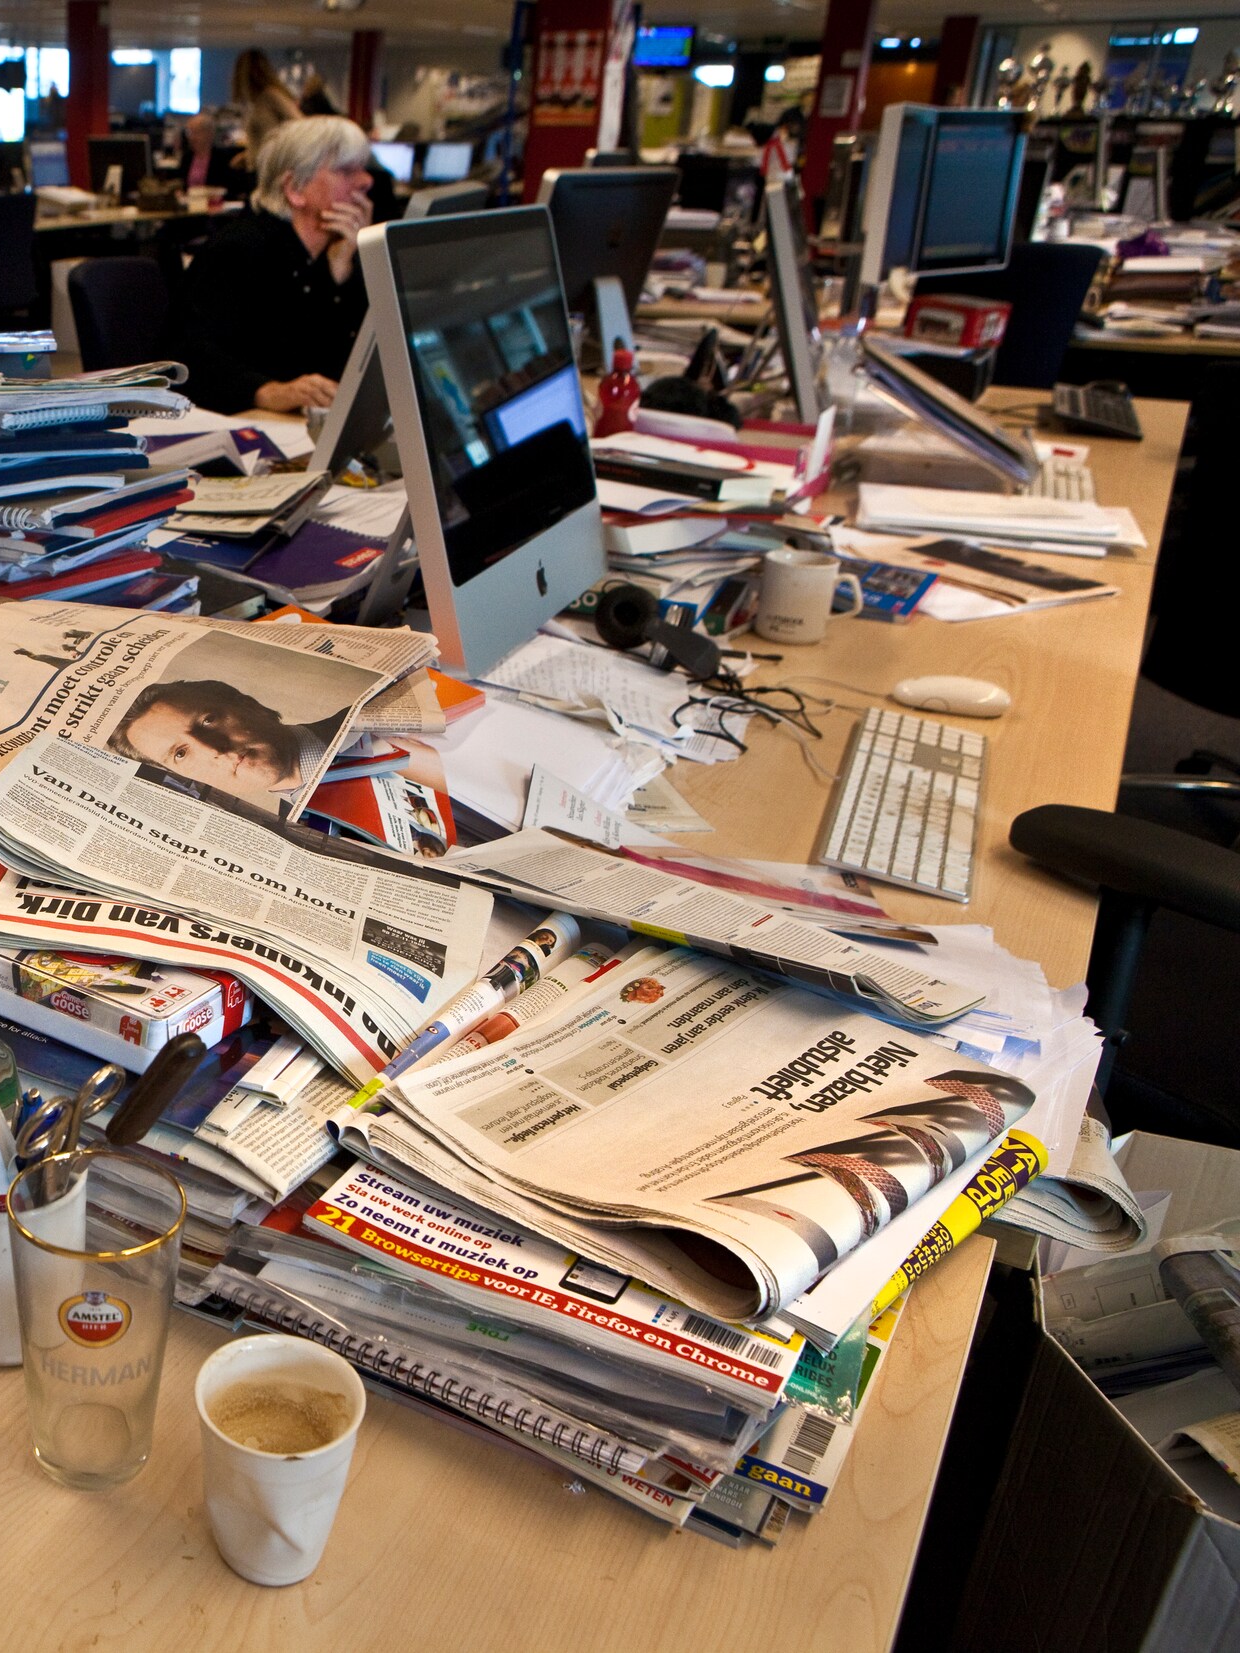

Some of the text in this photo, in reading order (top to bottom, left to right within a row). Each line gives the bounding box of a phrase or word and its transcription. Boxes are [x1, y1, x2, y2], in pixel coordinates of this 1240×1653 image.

[47, 674, 80, 717] moet
[74, 635, 123, 683] controle
[66, 628, 171, 729] strikt gaan scheiden
[82, 731, 94, 743] de
[90, 703, 113, 735] plannen
[109, 693, 121, 706] van
[31, 764, 73, 794] Van
[77, 789, 143, 831] Dalen
[148, 822, 209, 860] stapt
[213, 853, 246, 877] op
[250, 870, 288, 893] om
[295, 887, 356, 920] hotel
[107, 817, 150, 843] Amsterdam
[156, 842, 189, 863] opspraak
[189, 856, 207, 869] door
[207, 863, 234, 882] illegale
[17, 893, 97, 923] Dirk,
[108, 904, 180, 933] van
[386, 925, 416, 941] Waar was
[665, 977, 750, 1031] dan aan maanden.
[701, 1004, 738, 1028] eerder
[729, 991, 758, 1010] denk
[9, 1023, 48, 1043] for attack
[658, 1032, 693, 1055] jaren
[682, 1022, 708, 1039] aan
[611, 1047, 635, 1061] games
[749, 1029, 857, 1104] alstublieft
[469, 1069, 491, 1082] Barman
[575, 1053, 647, 1093] Smartphones, koelkasten,
[605, 1059, 660, 1090] Gadgetspecial
[790, 1040, 919, 1113] Niet blazen,
[558, 1103, 581, 1117] Het
[725, 1092, 747, 1107] Pagina
[528, 1111, 565, 1133] perfecte
[345, 1183, 493, 1251] Sla uw werk online op
[355, 1173, 525, 1248] Stream uw muziek
[333, 1192, 539, 1280] Zo neemt u muziek op
[316, 1205, 770, 1388] 21 Browsertips voor IE, Firefox en Chrome
[71, 1310, 119, 1321] AMSTEL
[81, 1323, 107, 1331] BIER
[40, 1355, 152, 1387] HERMAN
[794, 1365, 833, 1388] RIBES
[622, 1473, 674, 1507] WETEN
[747, 1463, 812, 1497] gaan
